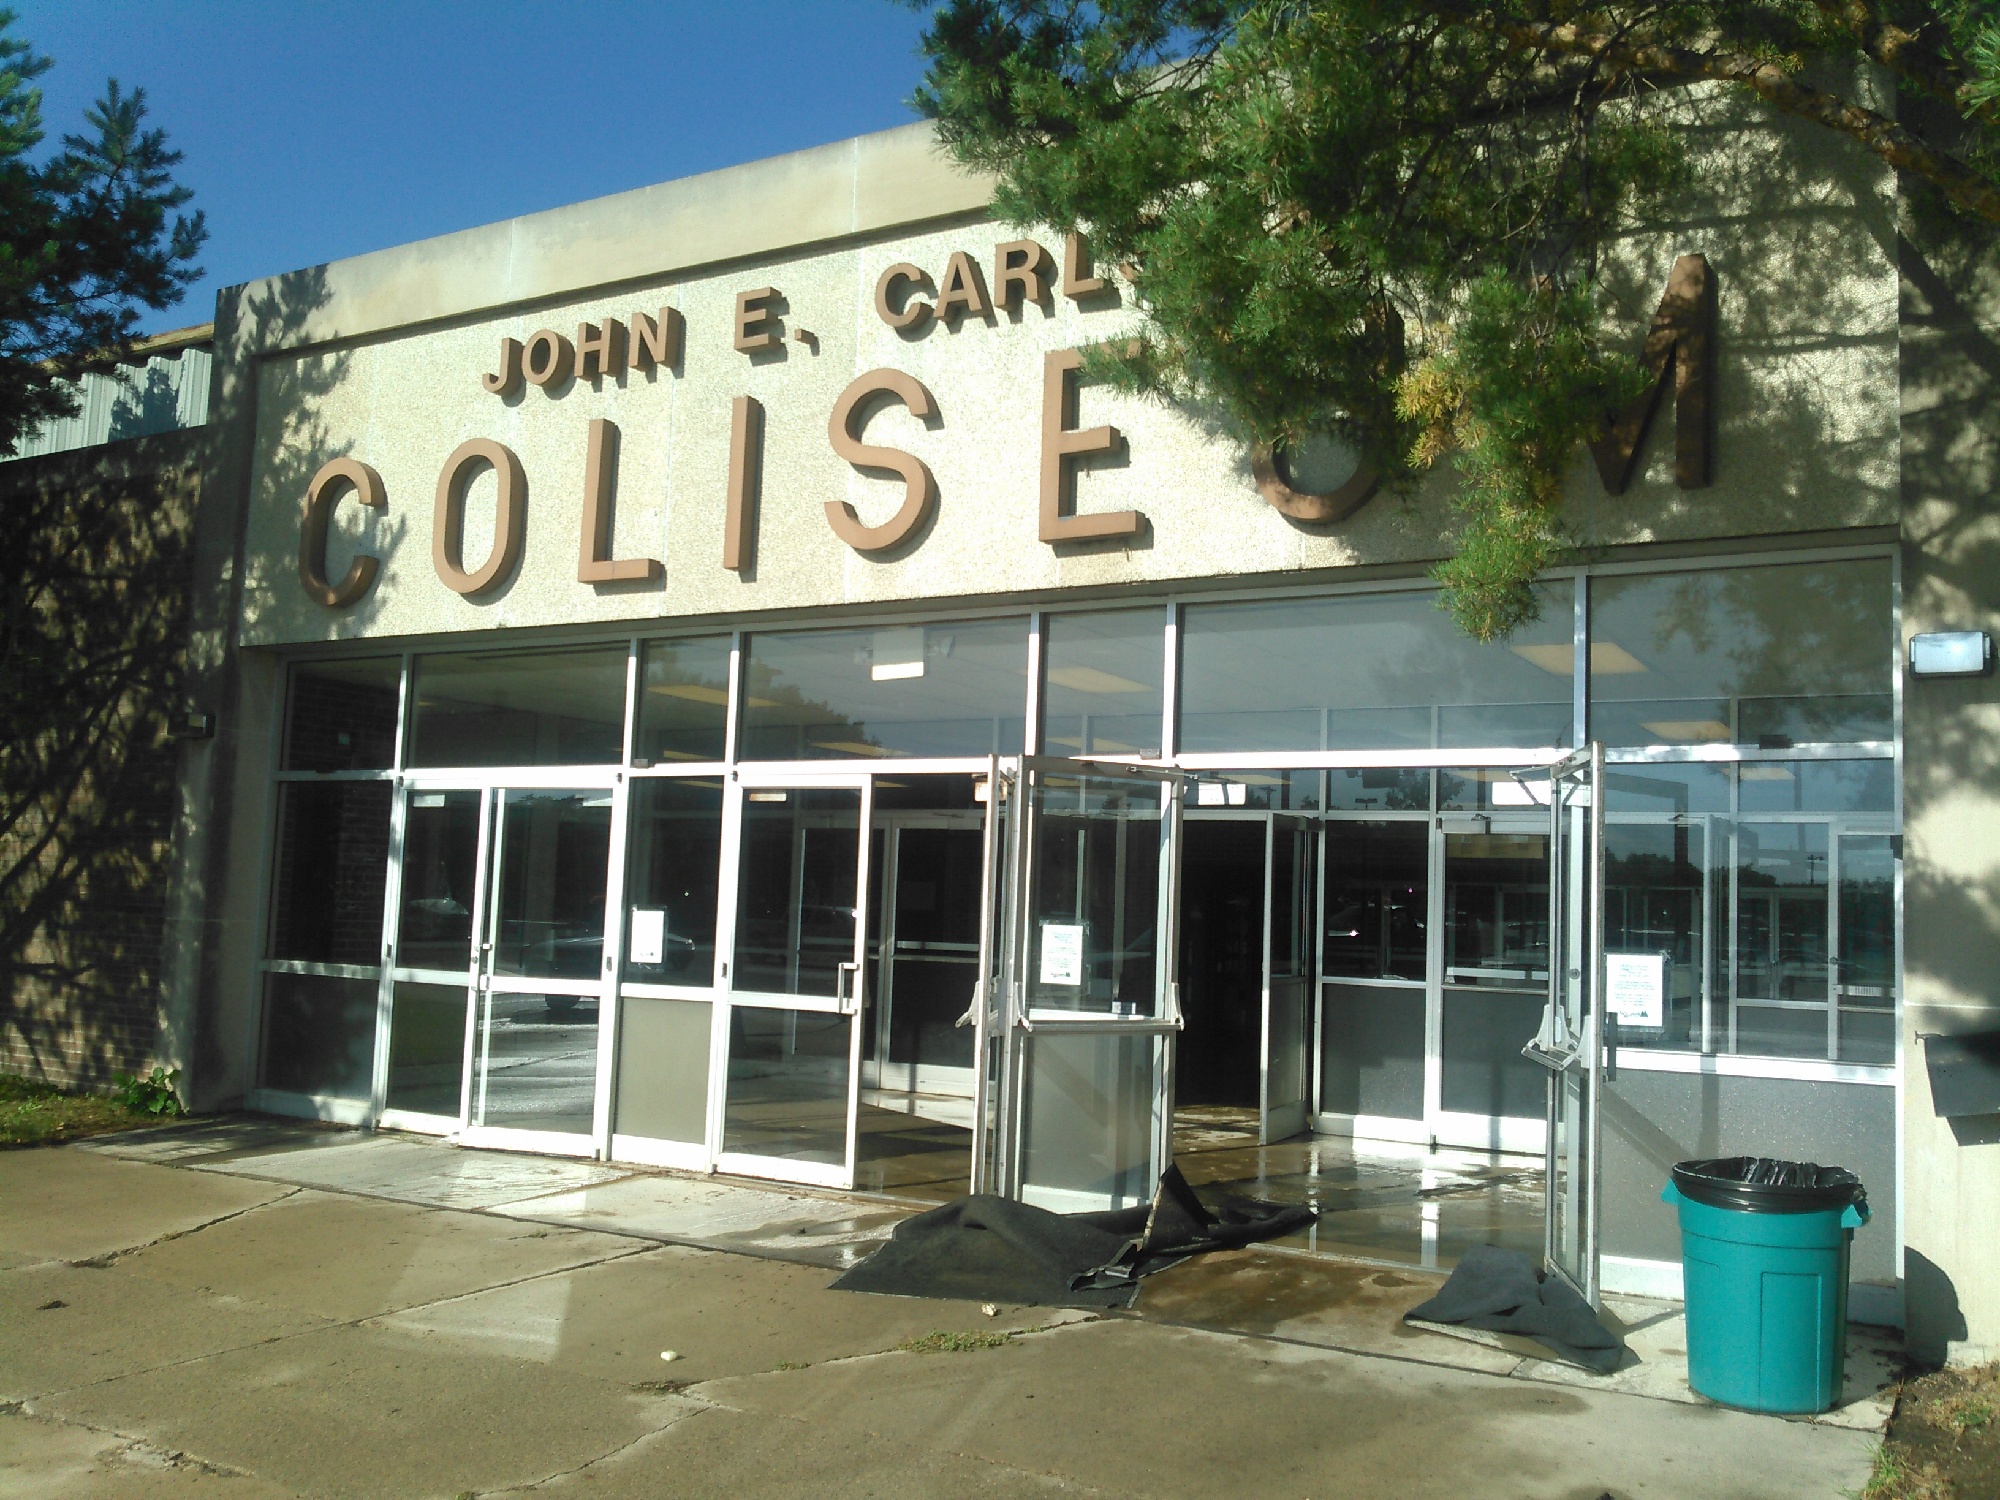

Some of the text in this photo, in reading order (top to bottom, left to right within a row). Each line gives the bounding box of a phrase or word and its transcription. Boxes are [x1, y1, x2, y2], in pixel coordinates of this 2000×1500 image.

[483, 231, 1138, 395] JOHN E. CARL
